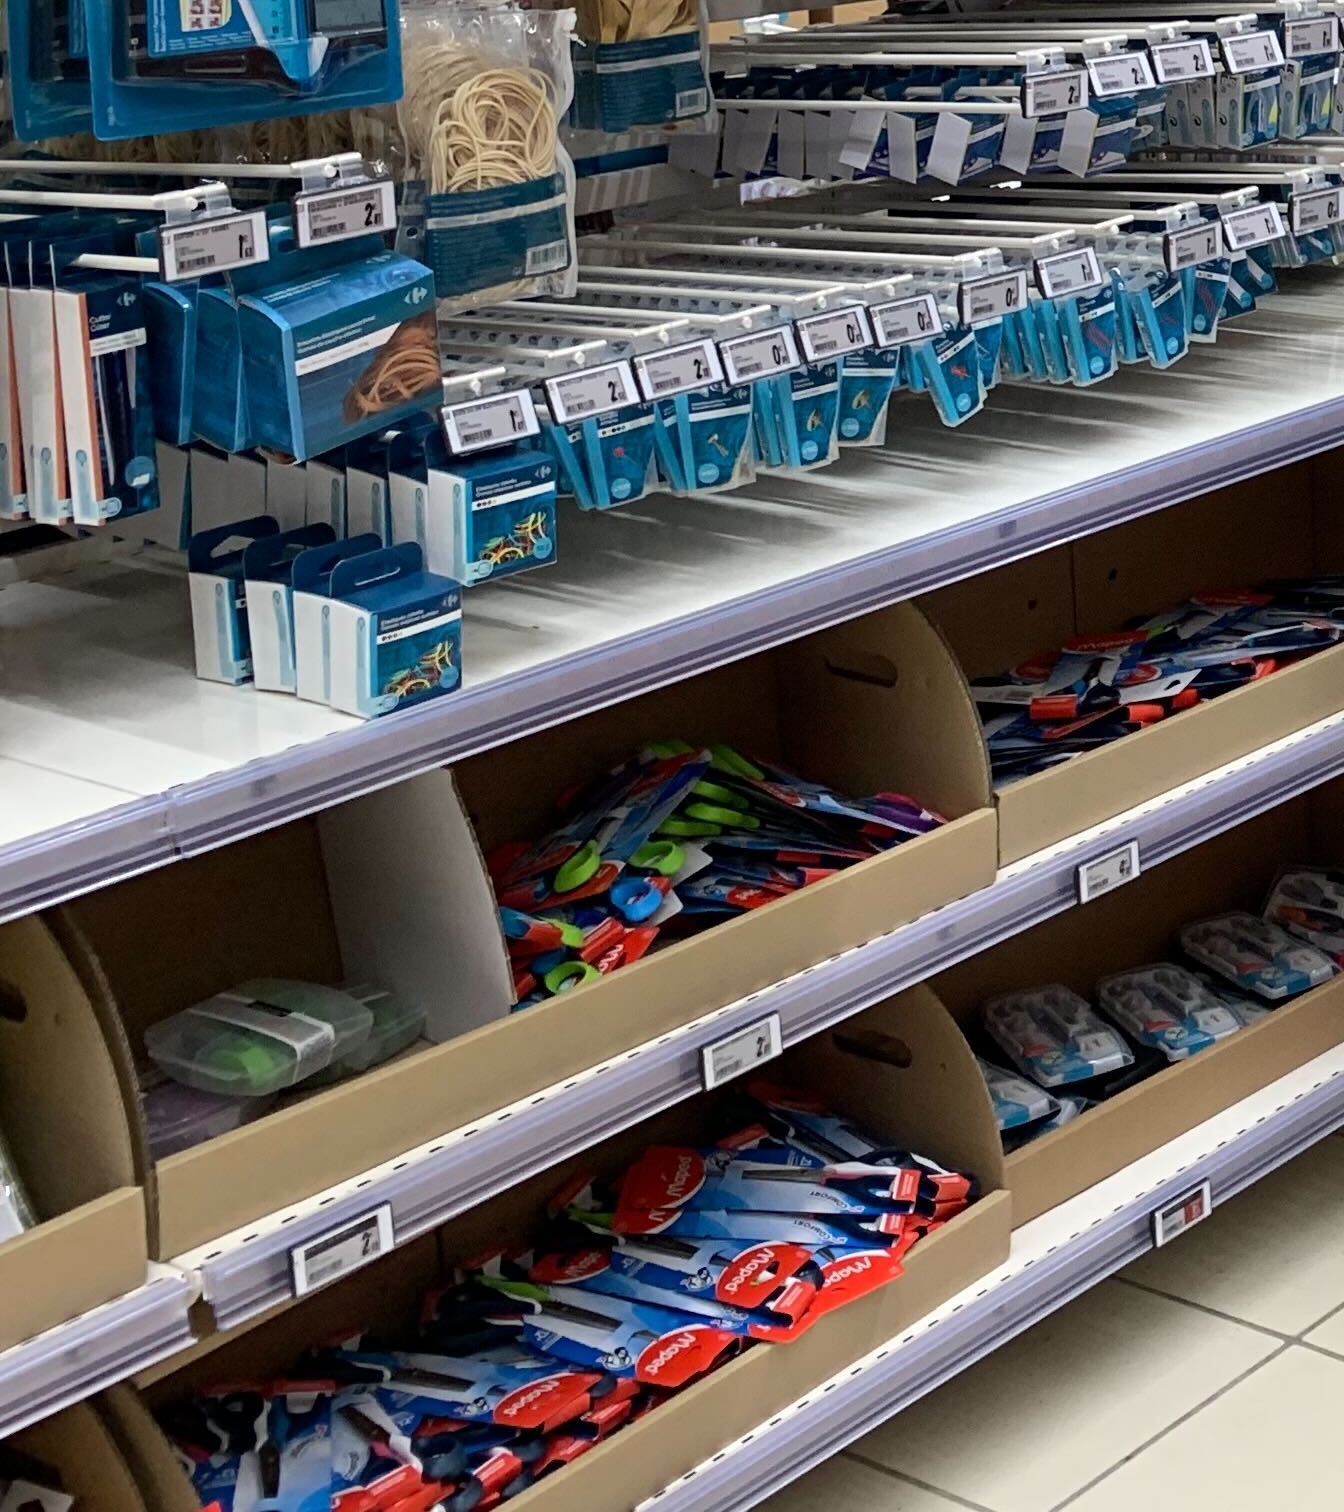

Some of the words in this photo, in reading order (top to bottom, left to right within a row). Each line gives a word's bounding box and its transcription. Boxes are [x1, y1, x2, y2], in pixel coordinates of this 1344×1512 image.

[723, 1245, 777, 1294] Maped
[822, 1256, 873, 1288] Mape
[644, 1331, 697, 1377] Maped
[502, 1379, 561, 1420] Maped
